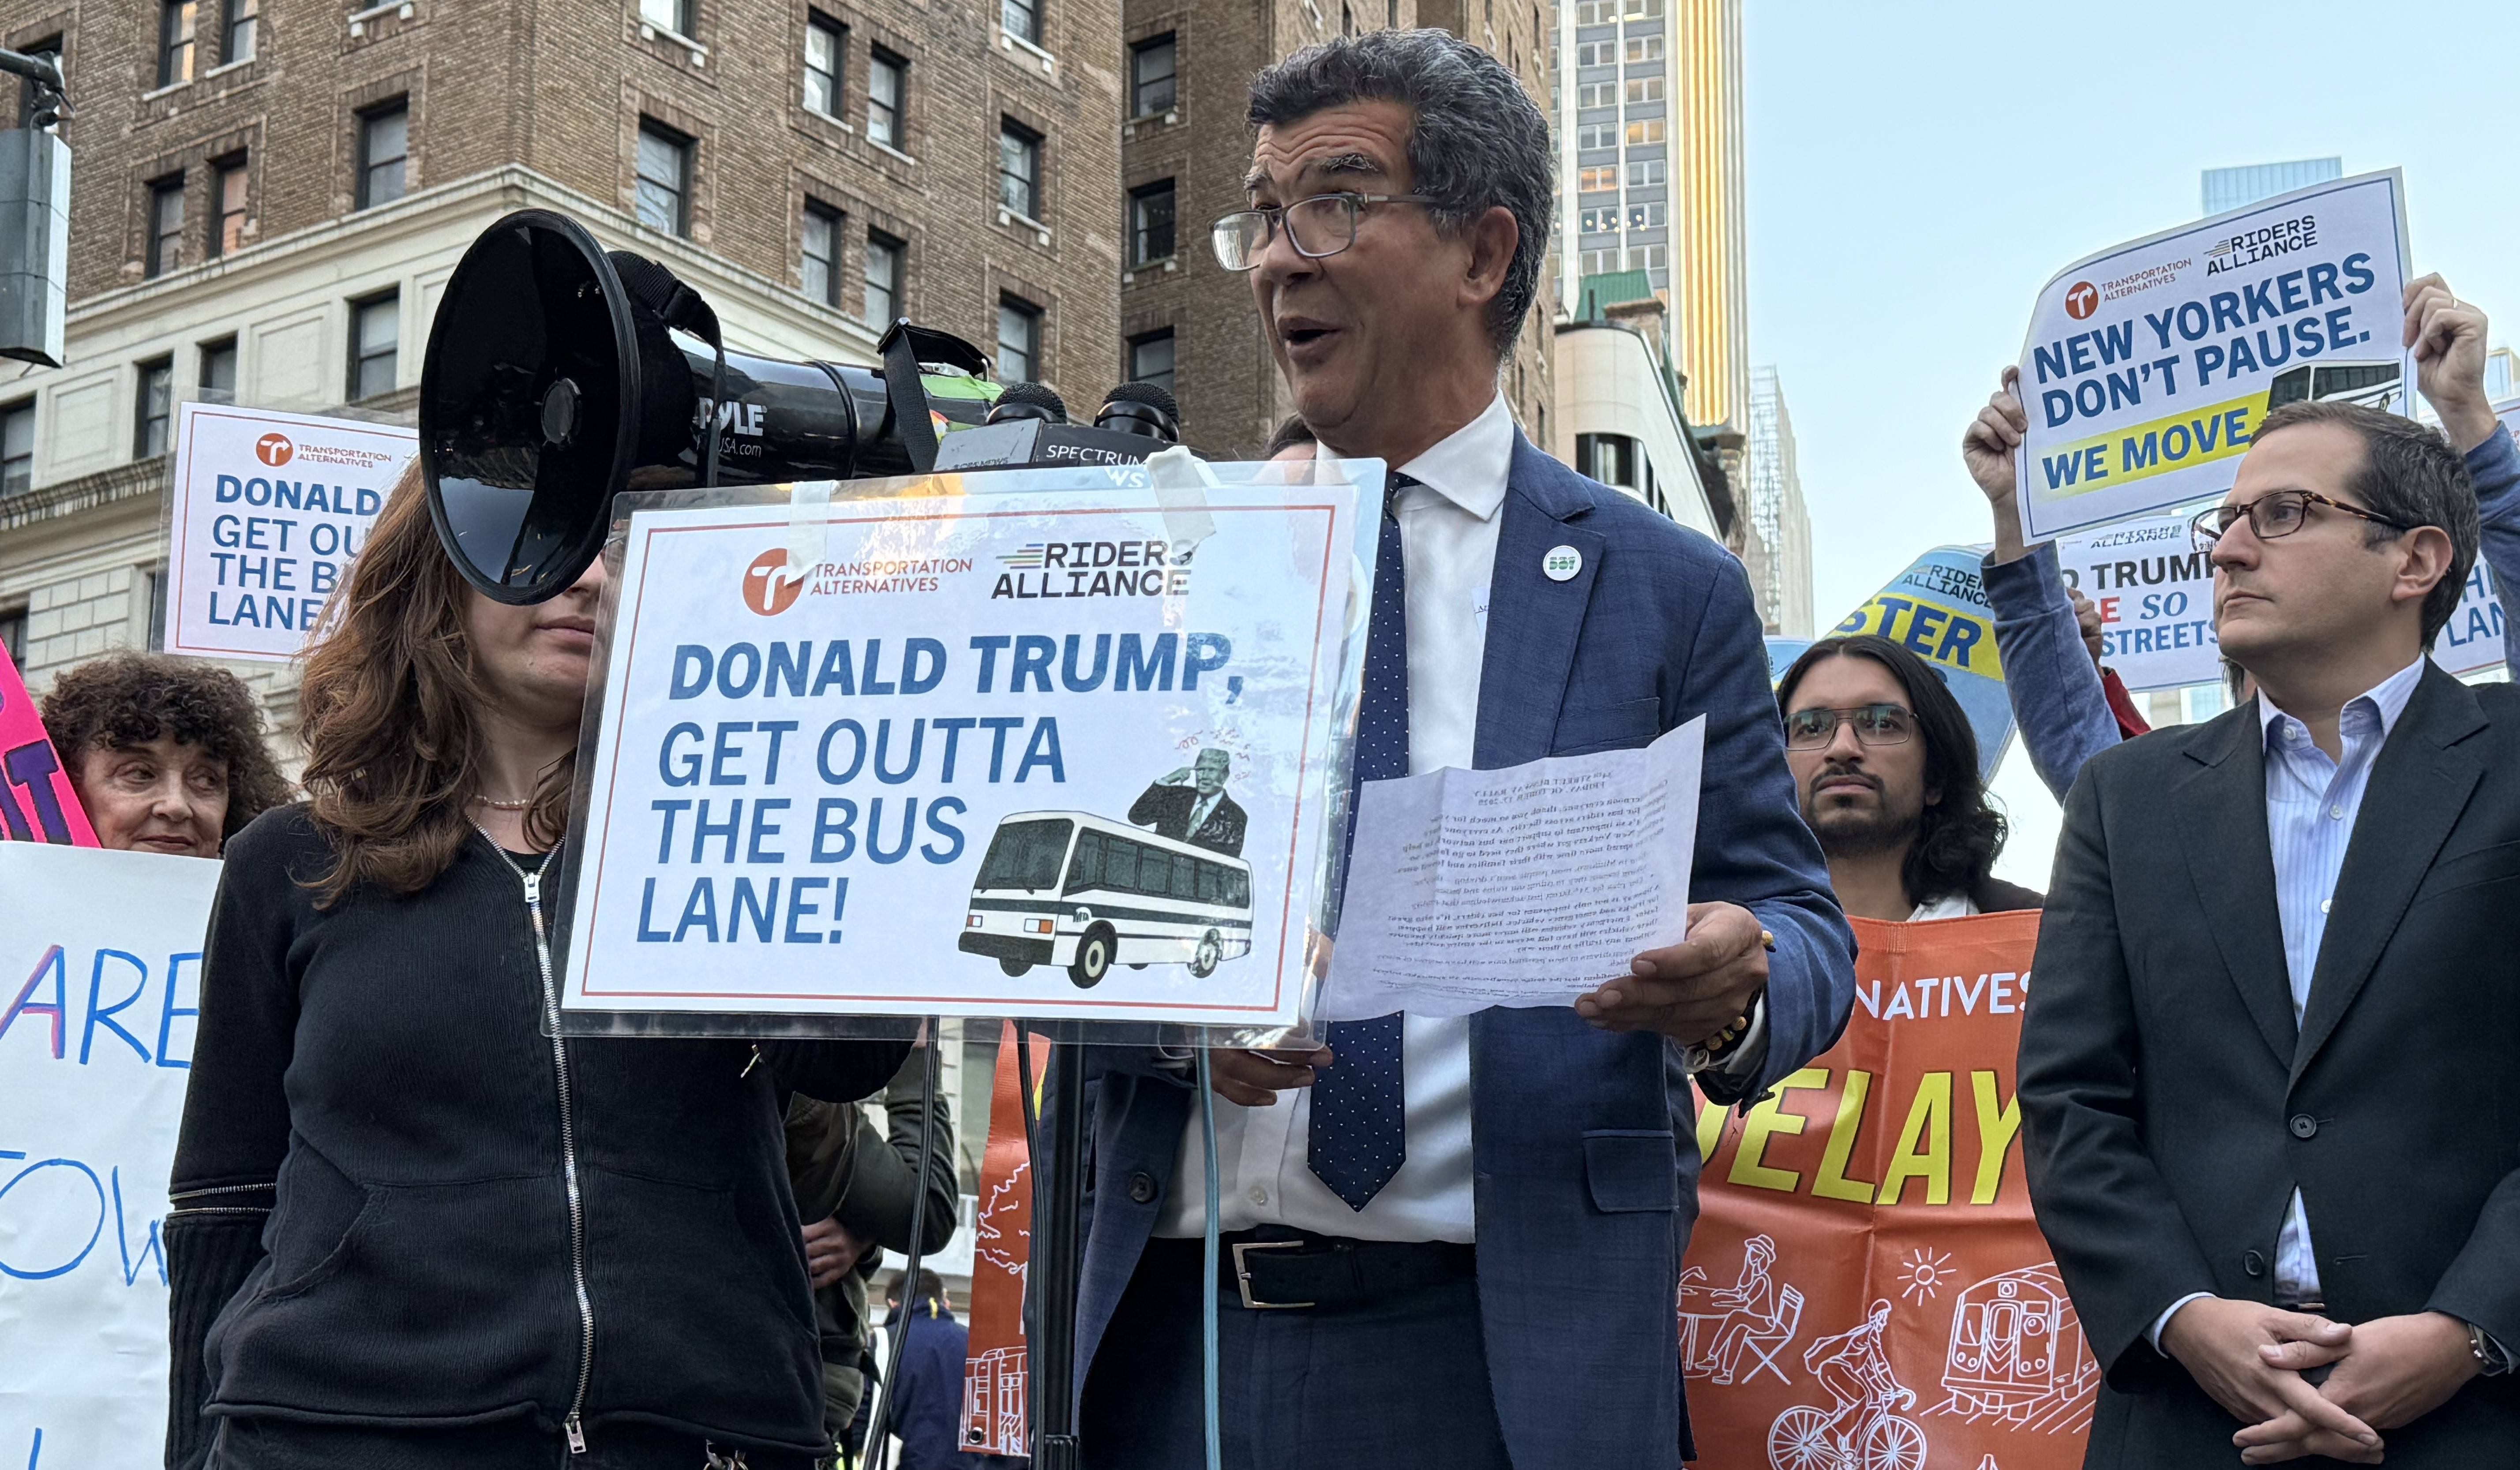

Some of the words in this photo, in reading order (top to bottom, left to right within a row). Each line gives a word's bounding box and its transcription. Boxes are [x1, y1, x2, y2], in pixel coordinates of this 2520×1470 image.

[2207, 230, 2318, 277] ALLIANCE
[2231, 215, 2315, 253] RIDERS
[2101, 258, 2192, 292] TRANSPORTATION
[2104, 273, 2176, 302] ALTERNATIVES
[2034, 319, 2133, 384] NEW
[2144, 252, 2375, 349] YORKERS
[2042, 355, 2180, 429] DON'T
[2195, 306, 2370, 386] PAUSE.
[699, 397, 764, 437] PYLE
[298, 453, 373, 468] ALTERNATIVES
[299, 444, 392, 462] TRANSPORTATION
[1047, 445, 1147, 466] SPECTRUM
[2042, 444, 2108, 490] WE
[2122, 407, 2250, 472] MOVE
[215, 474, 382, 515] DONALD
[213, 514, 297, 552] GET
[310, 523, 370, 558] OU
[210, 552, 297, 591] THE
[311, 561, 338, 595] B
[810, 576, 939, 596] ALTERNATIVES
[814, 557, 973, 579] TRANSPORTATION
[991, 569, 1191, 599] ALLIANCE
[2140, 591, 2188, 620] SO
[2101, 620, 2219, 657] STREETS
[669, 637, 947, 700] DONALD
[969, 632, 1244, 705] TRUMP,
[659, 720, 799, 788] GET
[817, 717, 1066, 785] OUTTA
[651, 798, 791, 864] THE
[810, 796, 968, 865] BUS
[637, 877, 849, 944] LANE!
